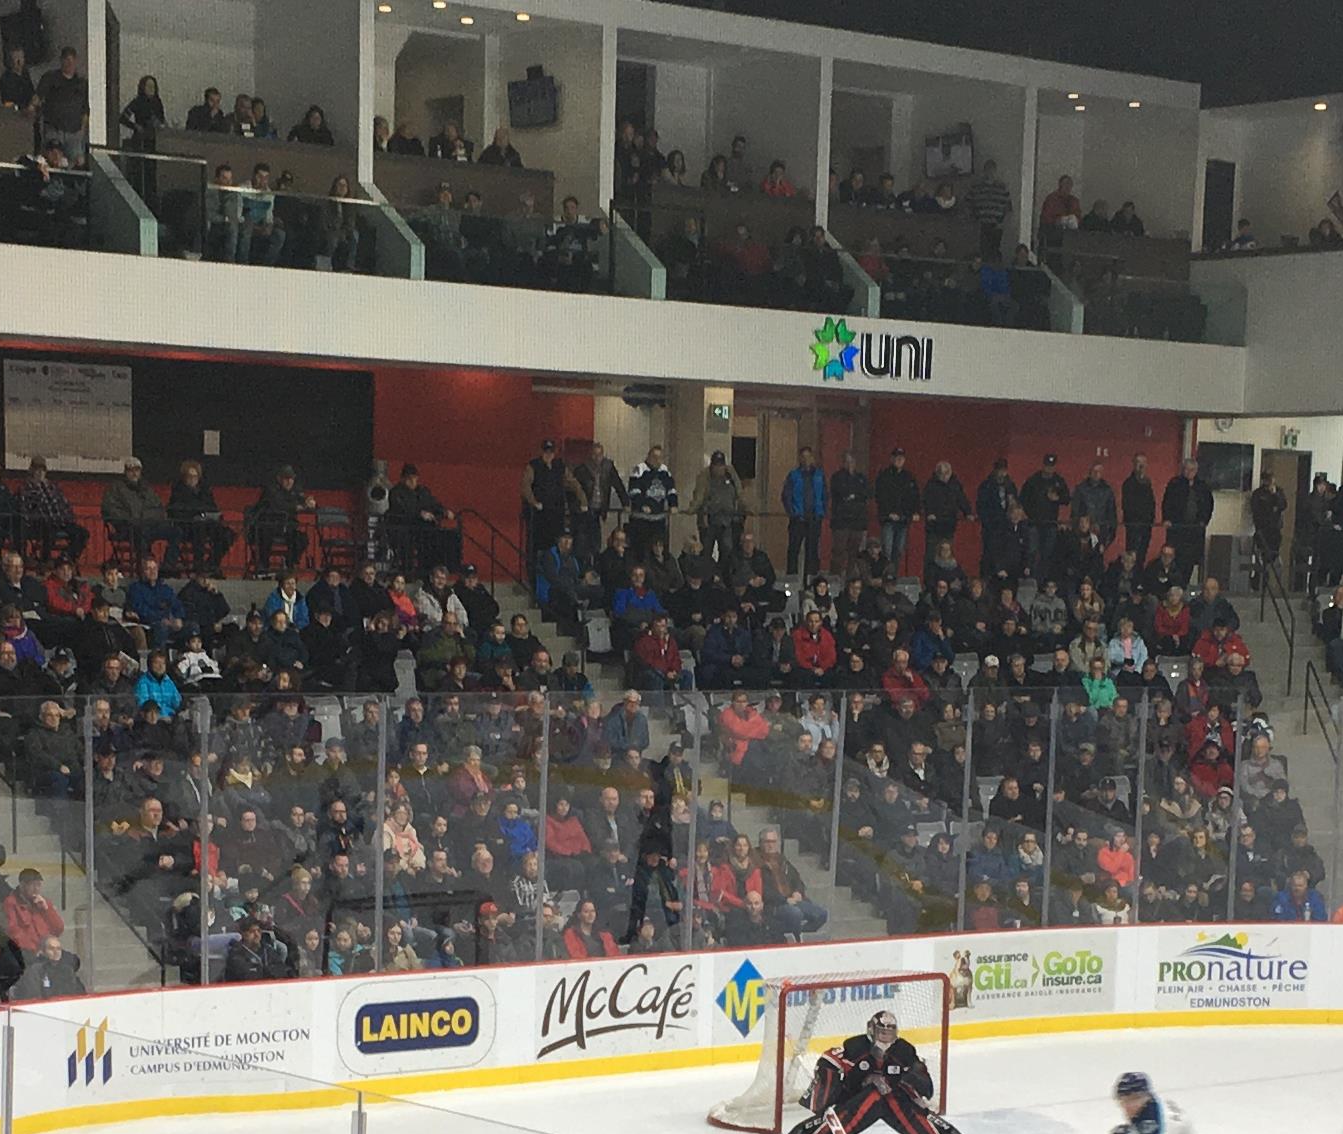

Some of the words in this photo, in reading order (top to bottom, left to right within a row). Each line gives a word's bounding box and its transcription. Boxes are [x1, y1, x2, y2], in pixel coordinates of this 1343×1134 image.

[976, 952, 1029, 964] assurance
[1044, 951, 1104, 976] GoTo
[1042, 974, 1103, 987] insure.ca
[1157, 985, 1184, 994] PLEIN
[1187, 984, 1204, 993] AIR
[1218, 984, 1258, 992] CHASSE
[1272, 982, 1306, 992] PÊCHE
[541, 963, 695, 1050] McCafé
[1190, 997, 1270, 1008] EDMUNDSTON
[362, 1008, 472, 1042] LAINCO
[129, 1032, 210, 1058] UNIVERSITÉ
[214, 1033, 232, 1047] DE
[236, 1028, 311, 1045] MONCTON
[130, 1062, 181, 1075] CAMPUS
